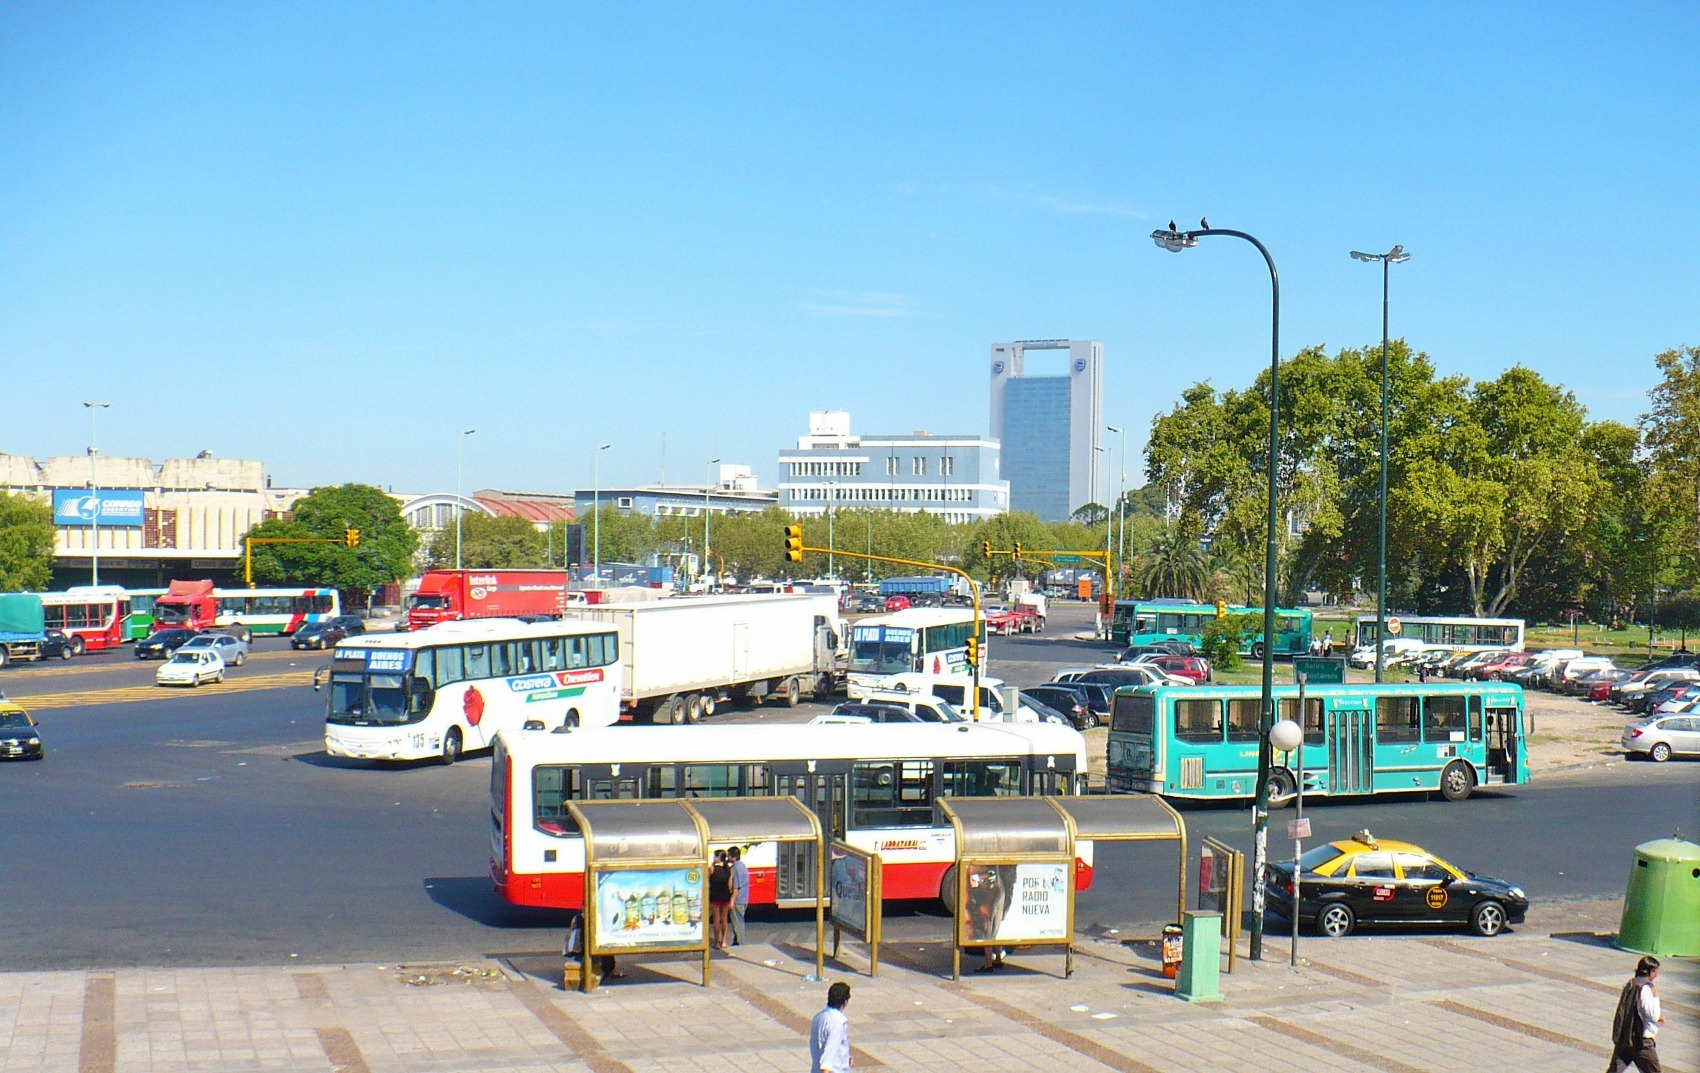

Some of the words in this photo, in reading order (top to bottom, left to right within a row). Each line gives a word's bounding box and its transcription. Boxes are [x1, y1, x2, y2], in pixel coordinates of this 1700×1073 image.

[344, 650, 366, 660] PLATA
[370, 651, 405, 661] BUENOS
[368, 660, 403, 670] AIRES
[413, 733, 425, 749] 135
[1239, 750, 1260, 758] LINE
[1022, 890, 1049, 902] RADIO
[1022, 904, 1050, 915] NUEVA
